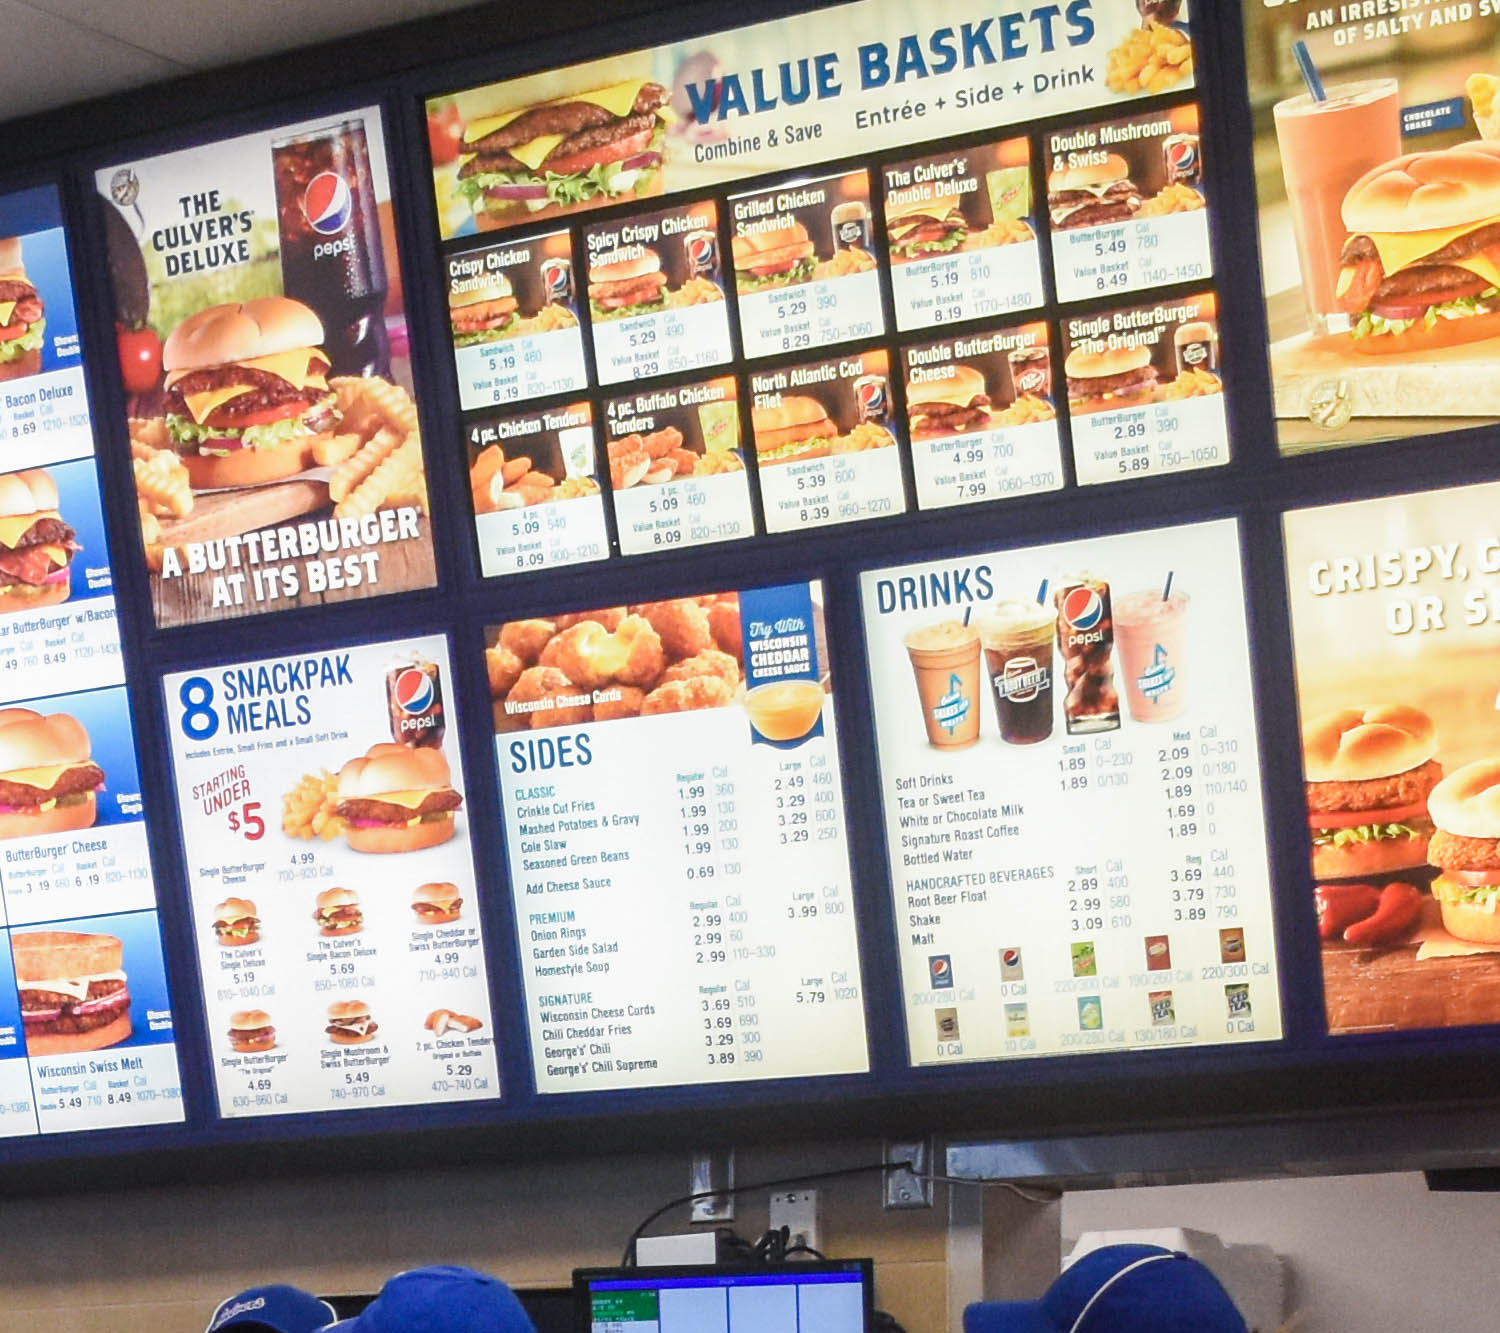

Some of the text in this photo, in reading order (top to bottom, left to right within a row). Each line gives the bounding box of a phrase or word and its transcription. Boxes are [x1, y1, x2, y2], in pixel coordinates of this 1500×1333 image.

[1334, 28, 1361, 46] OF
[1364, 17, 1422, 40] SALTY
[1430, 5, 1473, 28] AND
[858, 0, 1095, 91] BASKETS
[685, 53, 841, 124] VALUE
[856, 65, 1095, 129] Entrée Side Drink
[695, 123, 822, 162] Combine & Save
[180, 189, 219, 218] THE
[153, 211, 252, 252] CULVER'S
[314, 238, 355, 259] pepsi
[165, 241, 249, 277] DELUXE
[1069, 303, 1199, 338] Single ButterBurger
[163, 509, 419, 578] A BUTTERBURGER
[212, 552, 379, 608] AT ITS BEST
[1308, 542, 1469, 595] CRISPY,
[877, 565, 994, 615] DRINKS
[1387, 596, 1446, 635] OR
[1068, 630, 1103, 647] pepsi
[180, 655, 353, 741] 8 SNACKPAK
[226, 695, 311, 735] MEALS
[505, 689, 621, 715] Wisconsin Cheese Curds
[510, 733, 593, 774] SIDES
[192, 765, 245, 800] STARTING
[203, 779, 251, 816] UNDER
[895, 772, 953, 790] Soft Drinks
[229, 802, 265, 841] $5
[908, 889, 987, 908] Root Beer Float
[1172, 887, 1203, 902] 3.79
[531, 927, 586, 942] Onion Rings
[330, 963, 355, 975] 5.69
